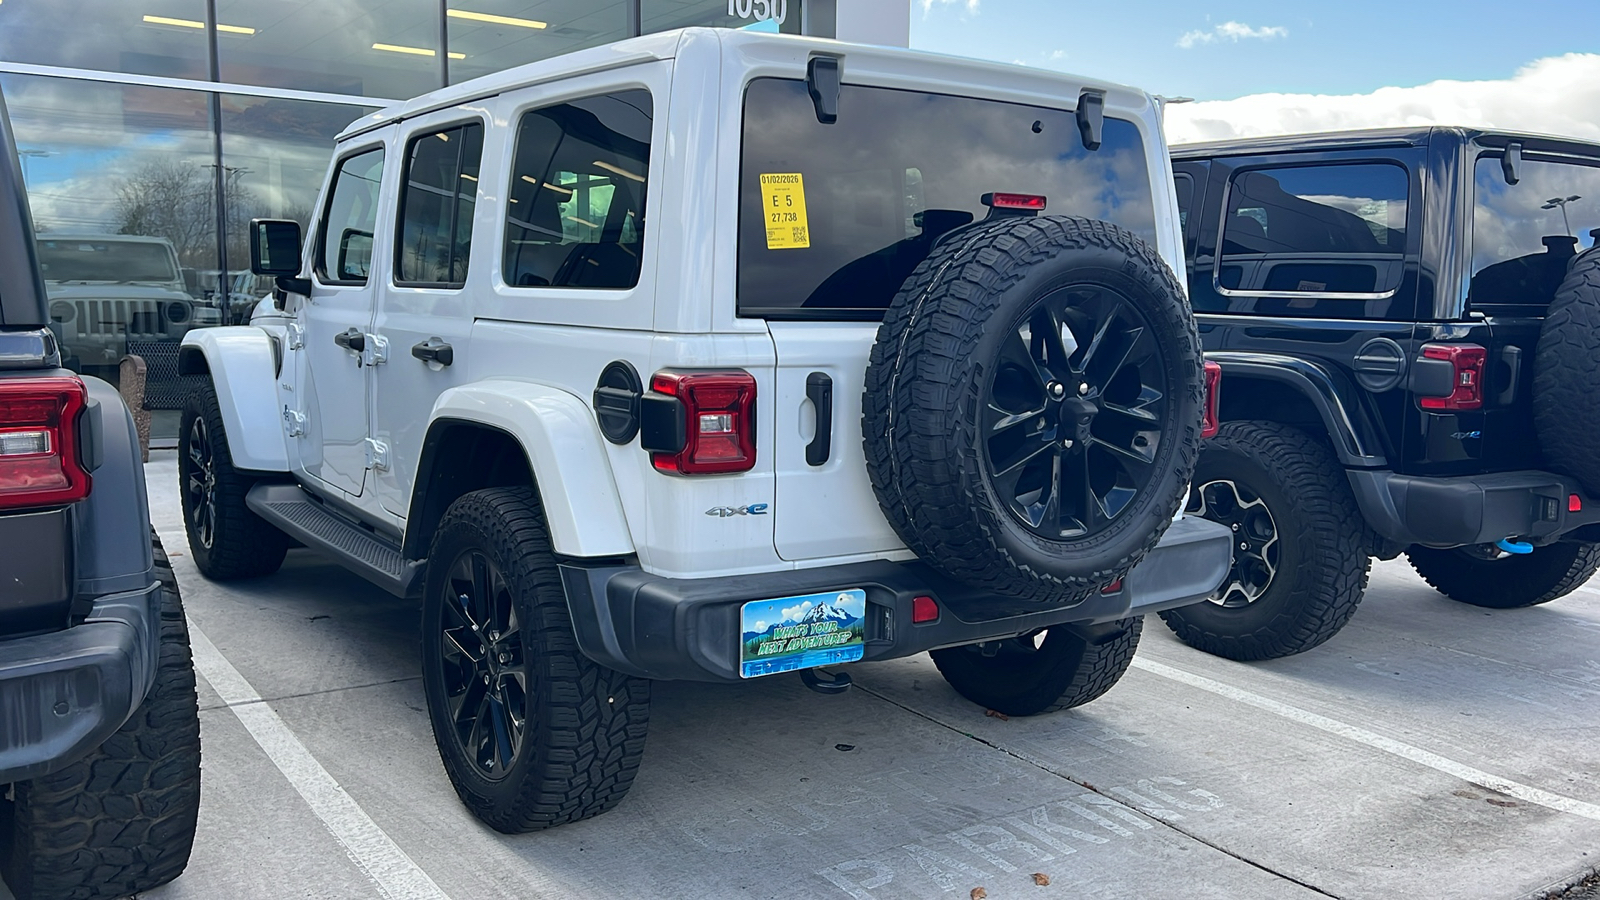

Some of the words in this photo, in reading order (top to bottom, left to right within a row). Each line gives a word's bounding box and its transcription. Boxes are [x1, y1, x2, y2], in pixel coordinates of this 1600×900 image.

[727, 0, 787, 25] 1050
[762, 175, 799, 184] 01/02/2026
[772, 195, 779, 207] E
[786, 195, 793, 207] 5
[771, 212, 798, 223] 27,738
[773, 623, 809, 641] WHAT'S
[811, 621, 838, 635] YOUR
[757, 639, 787, 656] NEXT
[787, 632, 853, 652] ADVENTURE?
[818, 775, 1226, 900] PARKING
